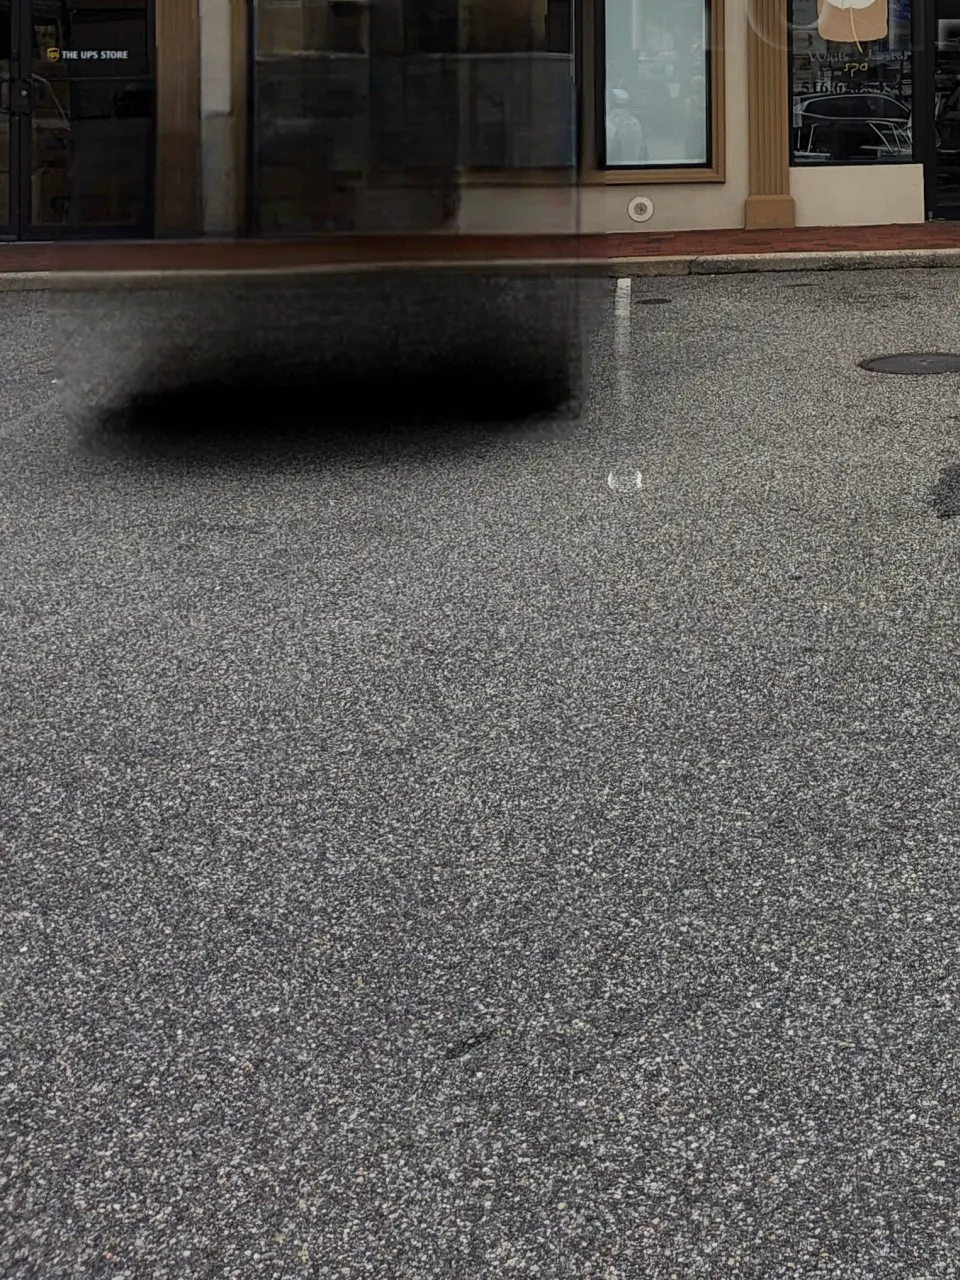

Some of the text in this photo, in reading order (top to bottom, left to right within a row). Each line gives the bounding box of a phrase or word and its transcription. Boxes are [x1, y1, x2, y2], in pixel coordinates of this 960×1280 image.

[62, 51, 129, 59] THE UPS STORE
[844, 62, 869, 78] spa
